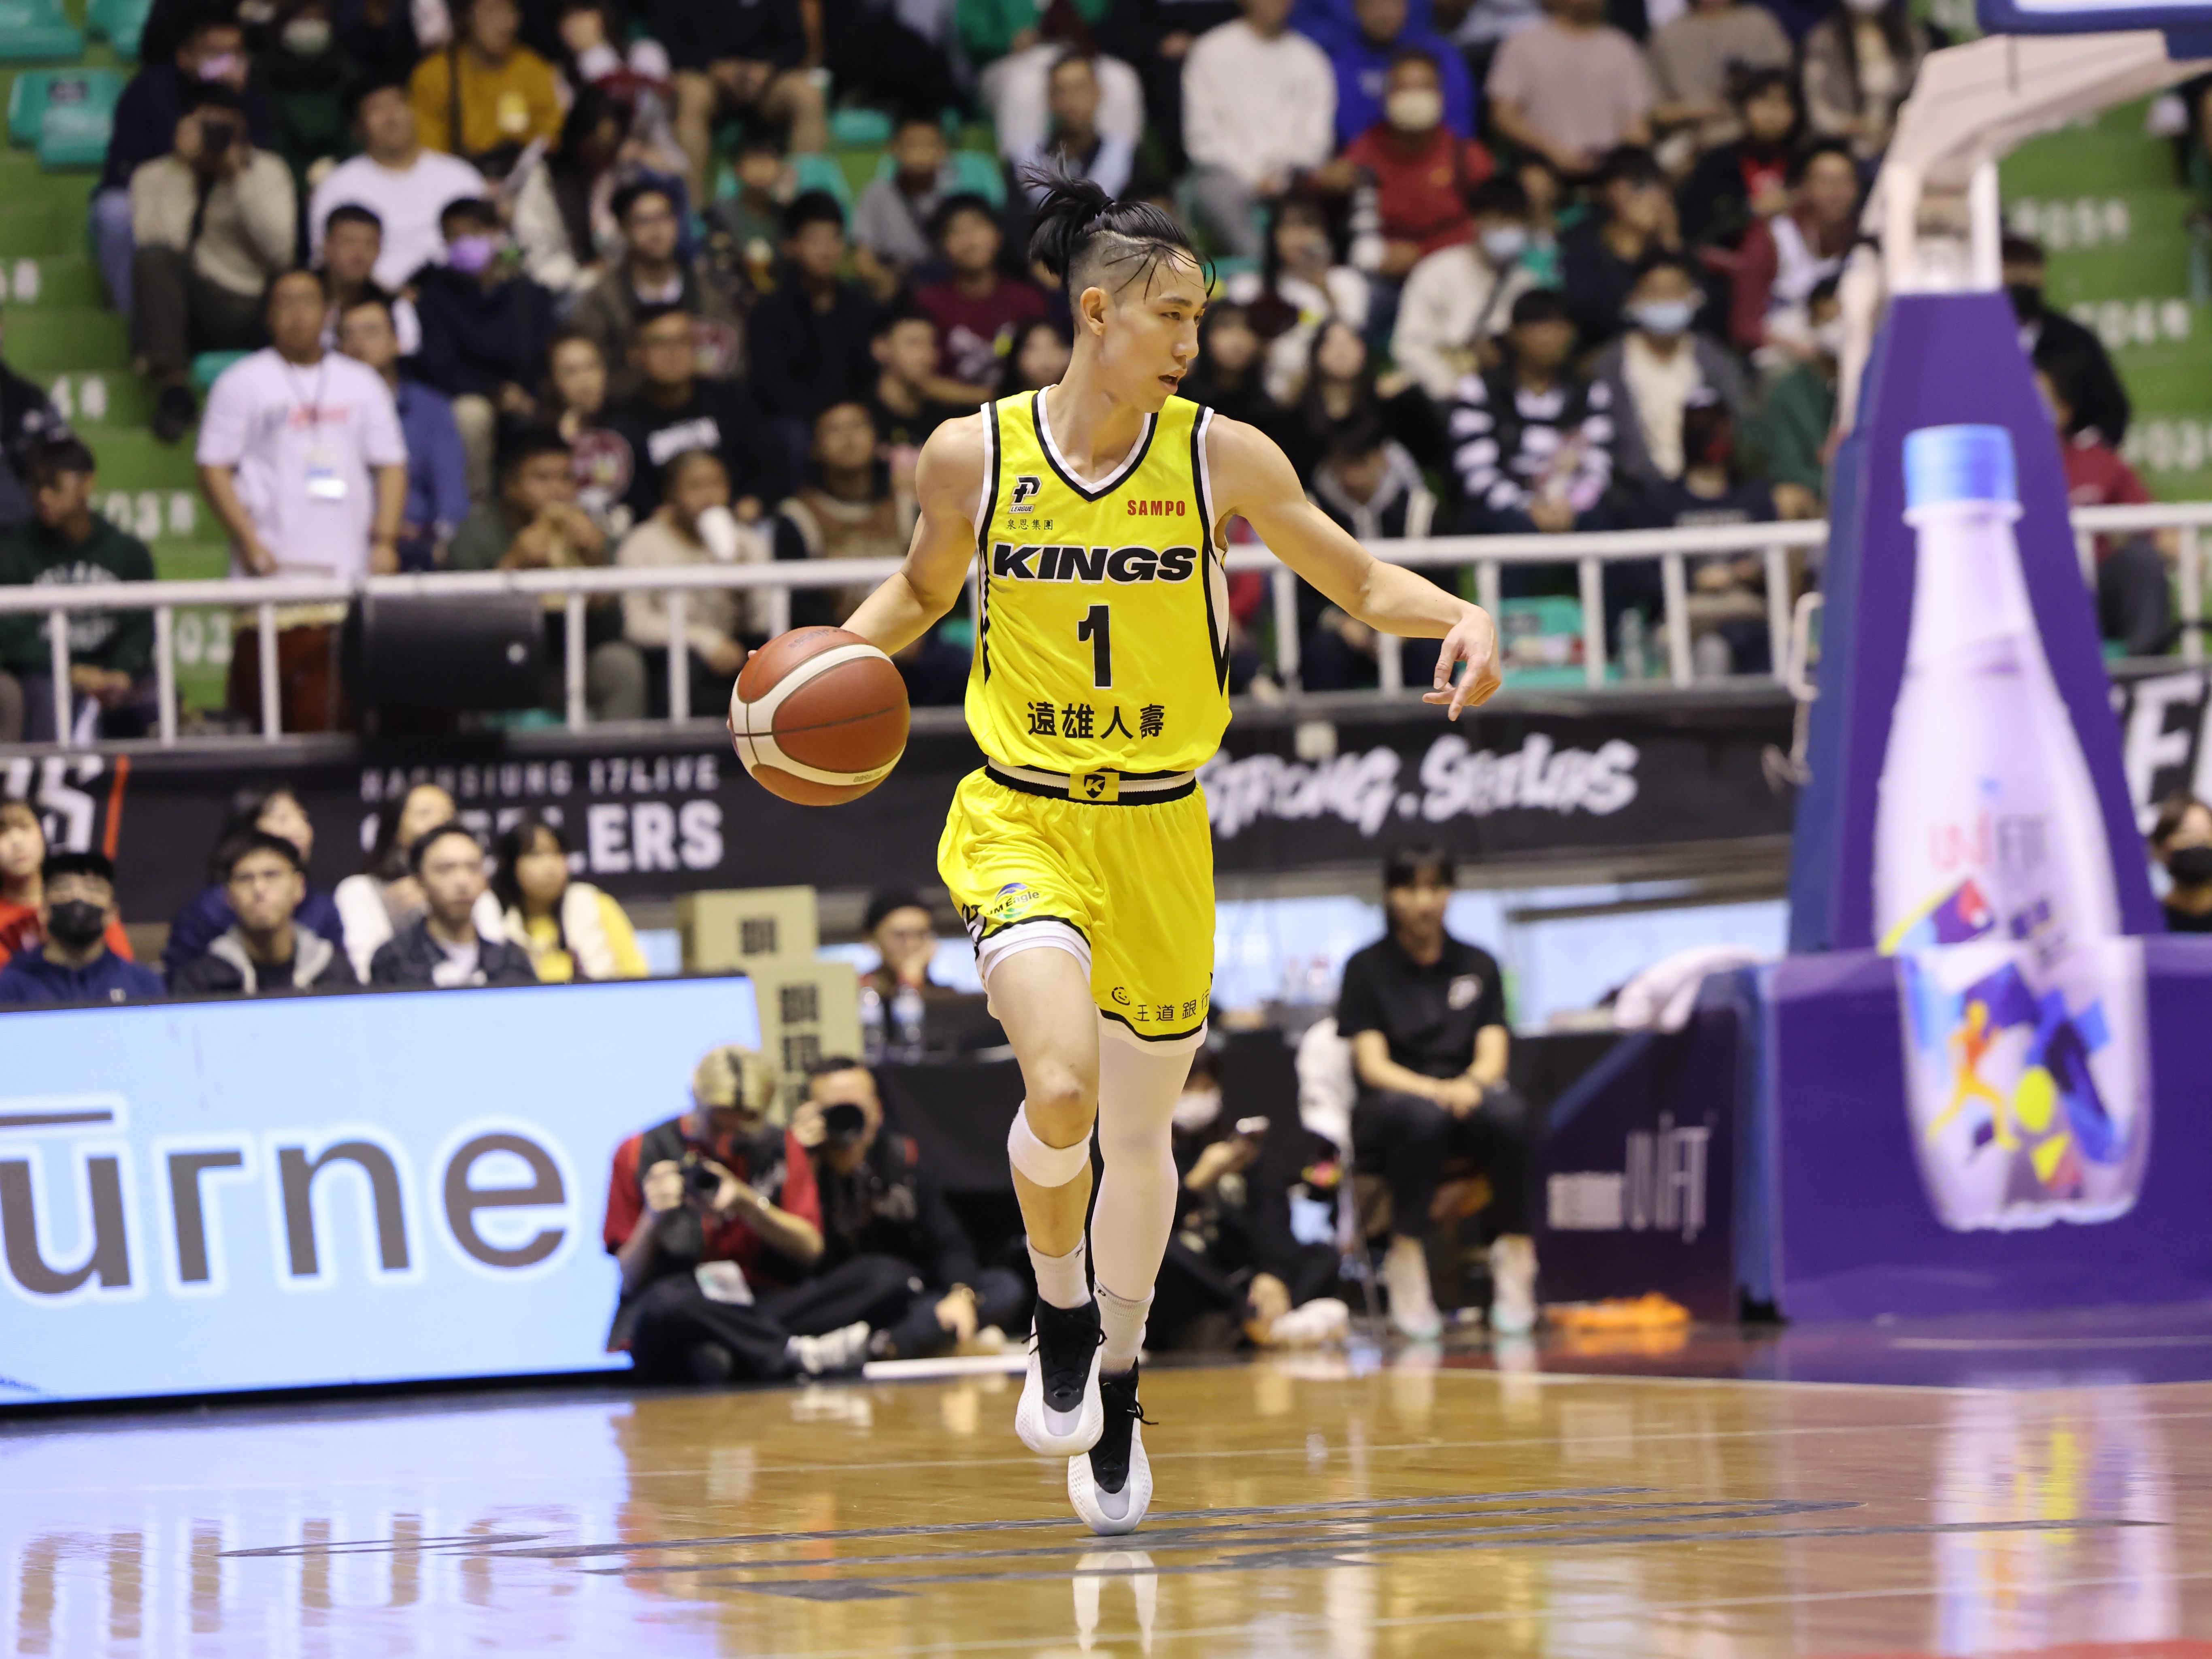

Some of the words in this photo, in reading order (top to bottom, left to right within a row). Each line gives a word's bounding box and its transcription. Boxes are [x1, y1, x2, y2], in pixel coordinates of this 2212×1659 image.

[1006, 518, 1053, 530] 泉恩集團
[1127, 500, 1185, 516] SAMPO
[993, 543, 1197, 584] KINGS
[1078, 605, 1112, 688] 1
[1027, 701, 1165, 739] 遠雄人壽
[1006, 891, 1039, 907] Eagle
[1134, 988, 1209, 1022] 王道銀行
